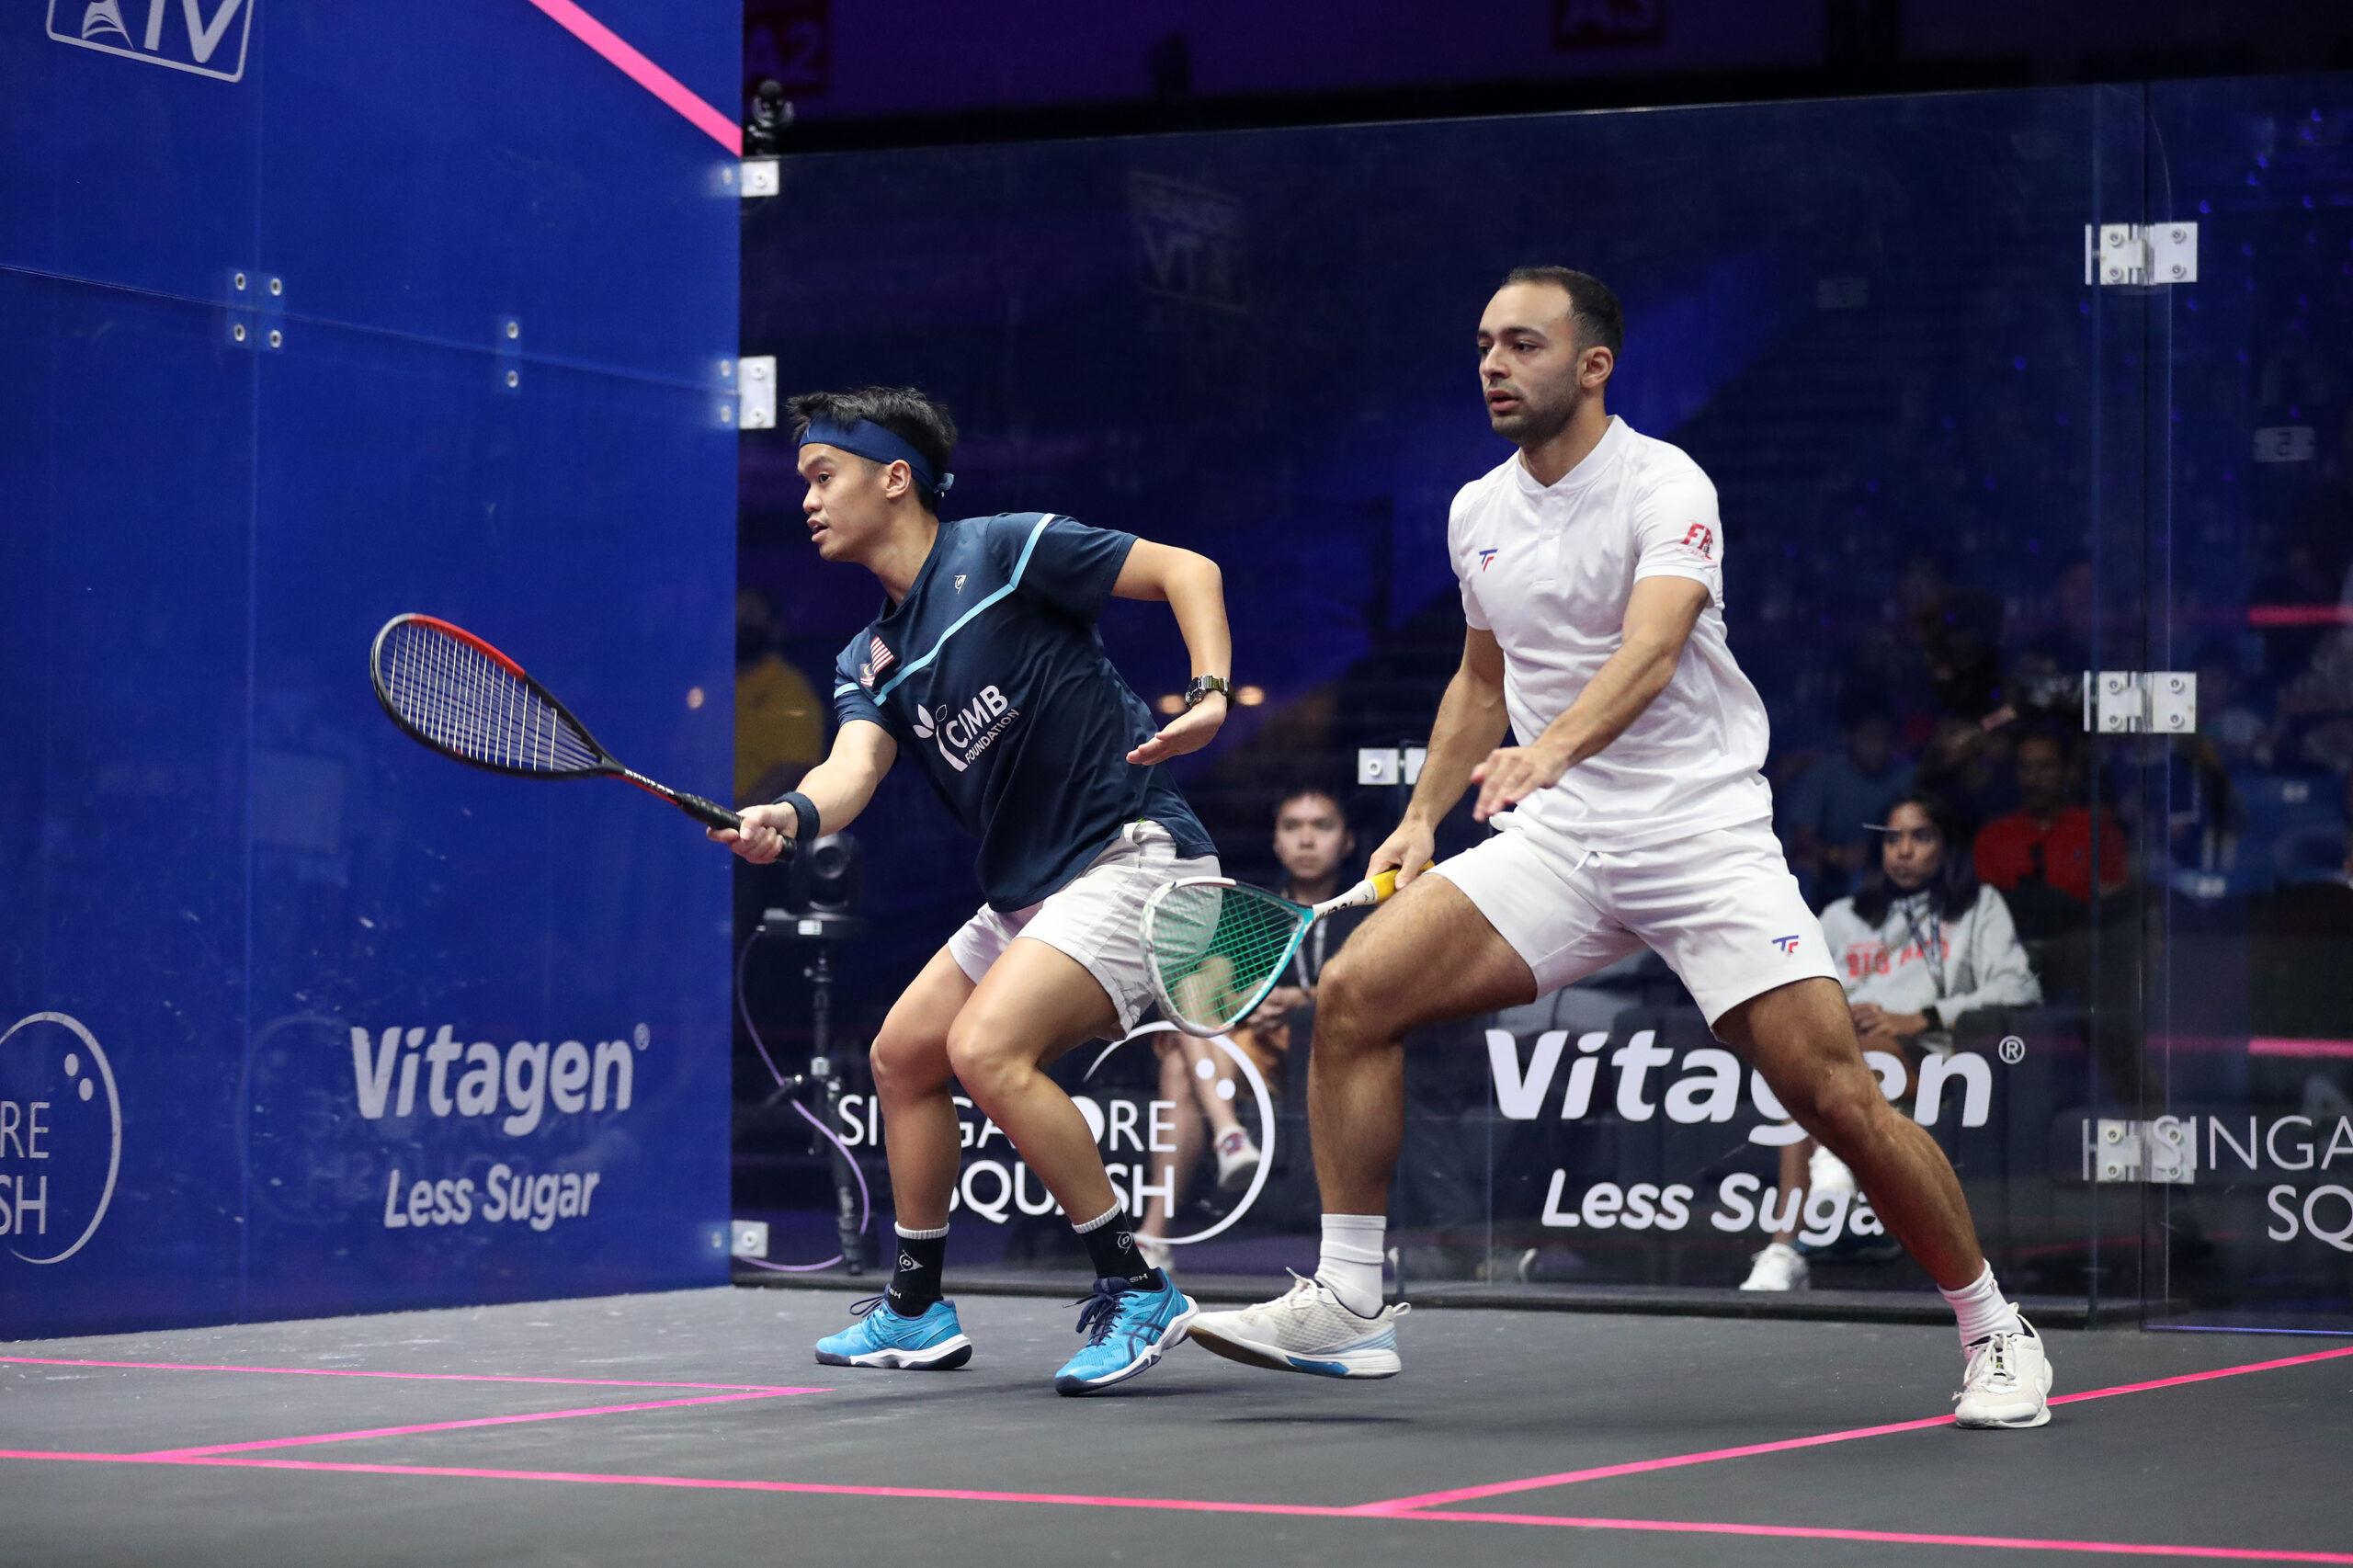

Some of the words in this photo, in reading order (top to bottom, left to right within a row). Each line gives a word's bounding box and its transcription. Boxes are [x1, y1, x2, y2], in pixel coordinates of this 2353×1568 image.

[946, 685, 1008, 749] CIMB
[965, 708, 1020, 765] FOUNDATION
[384, 1168, 474, 1228] Less
[483, 1163, 600, 1232] Sugar
[949, 1159, 1176, 1224] QUSH
[1541, 1168, 1694, 1231] Less
[1711, 1172, 1885, 1247] Suga
[2268, 1185, 2353, 1253] SQ
